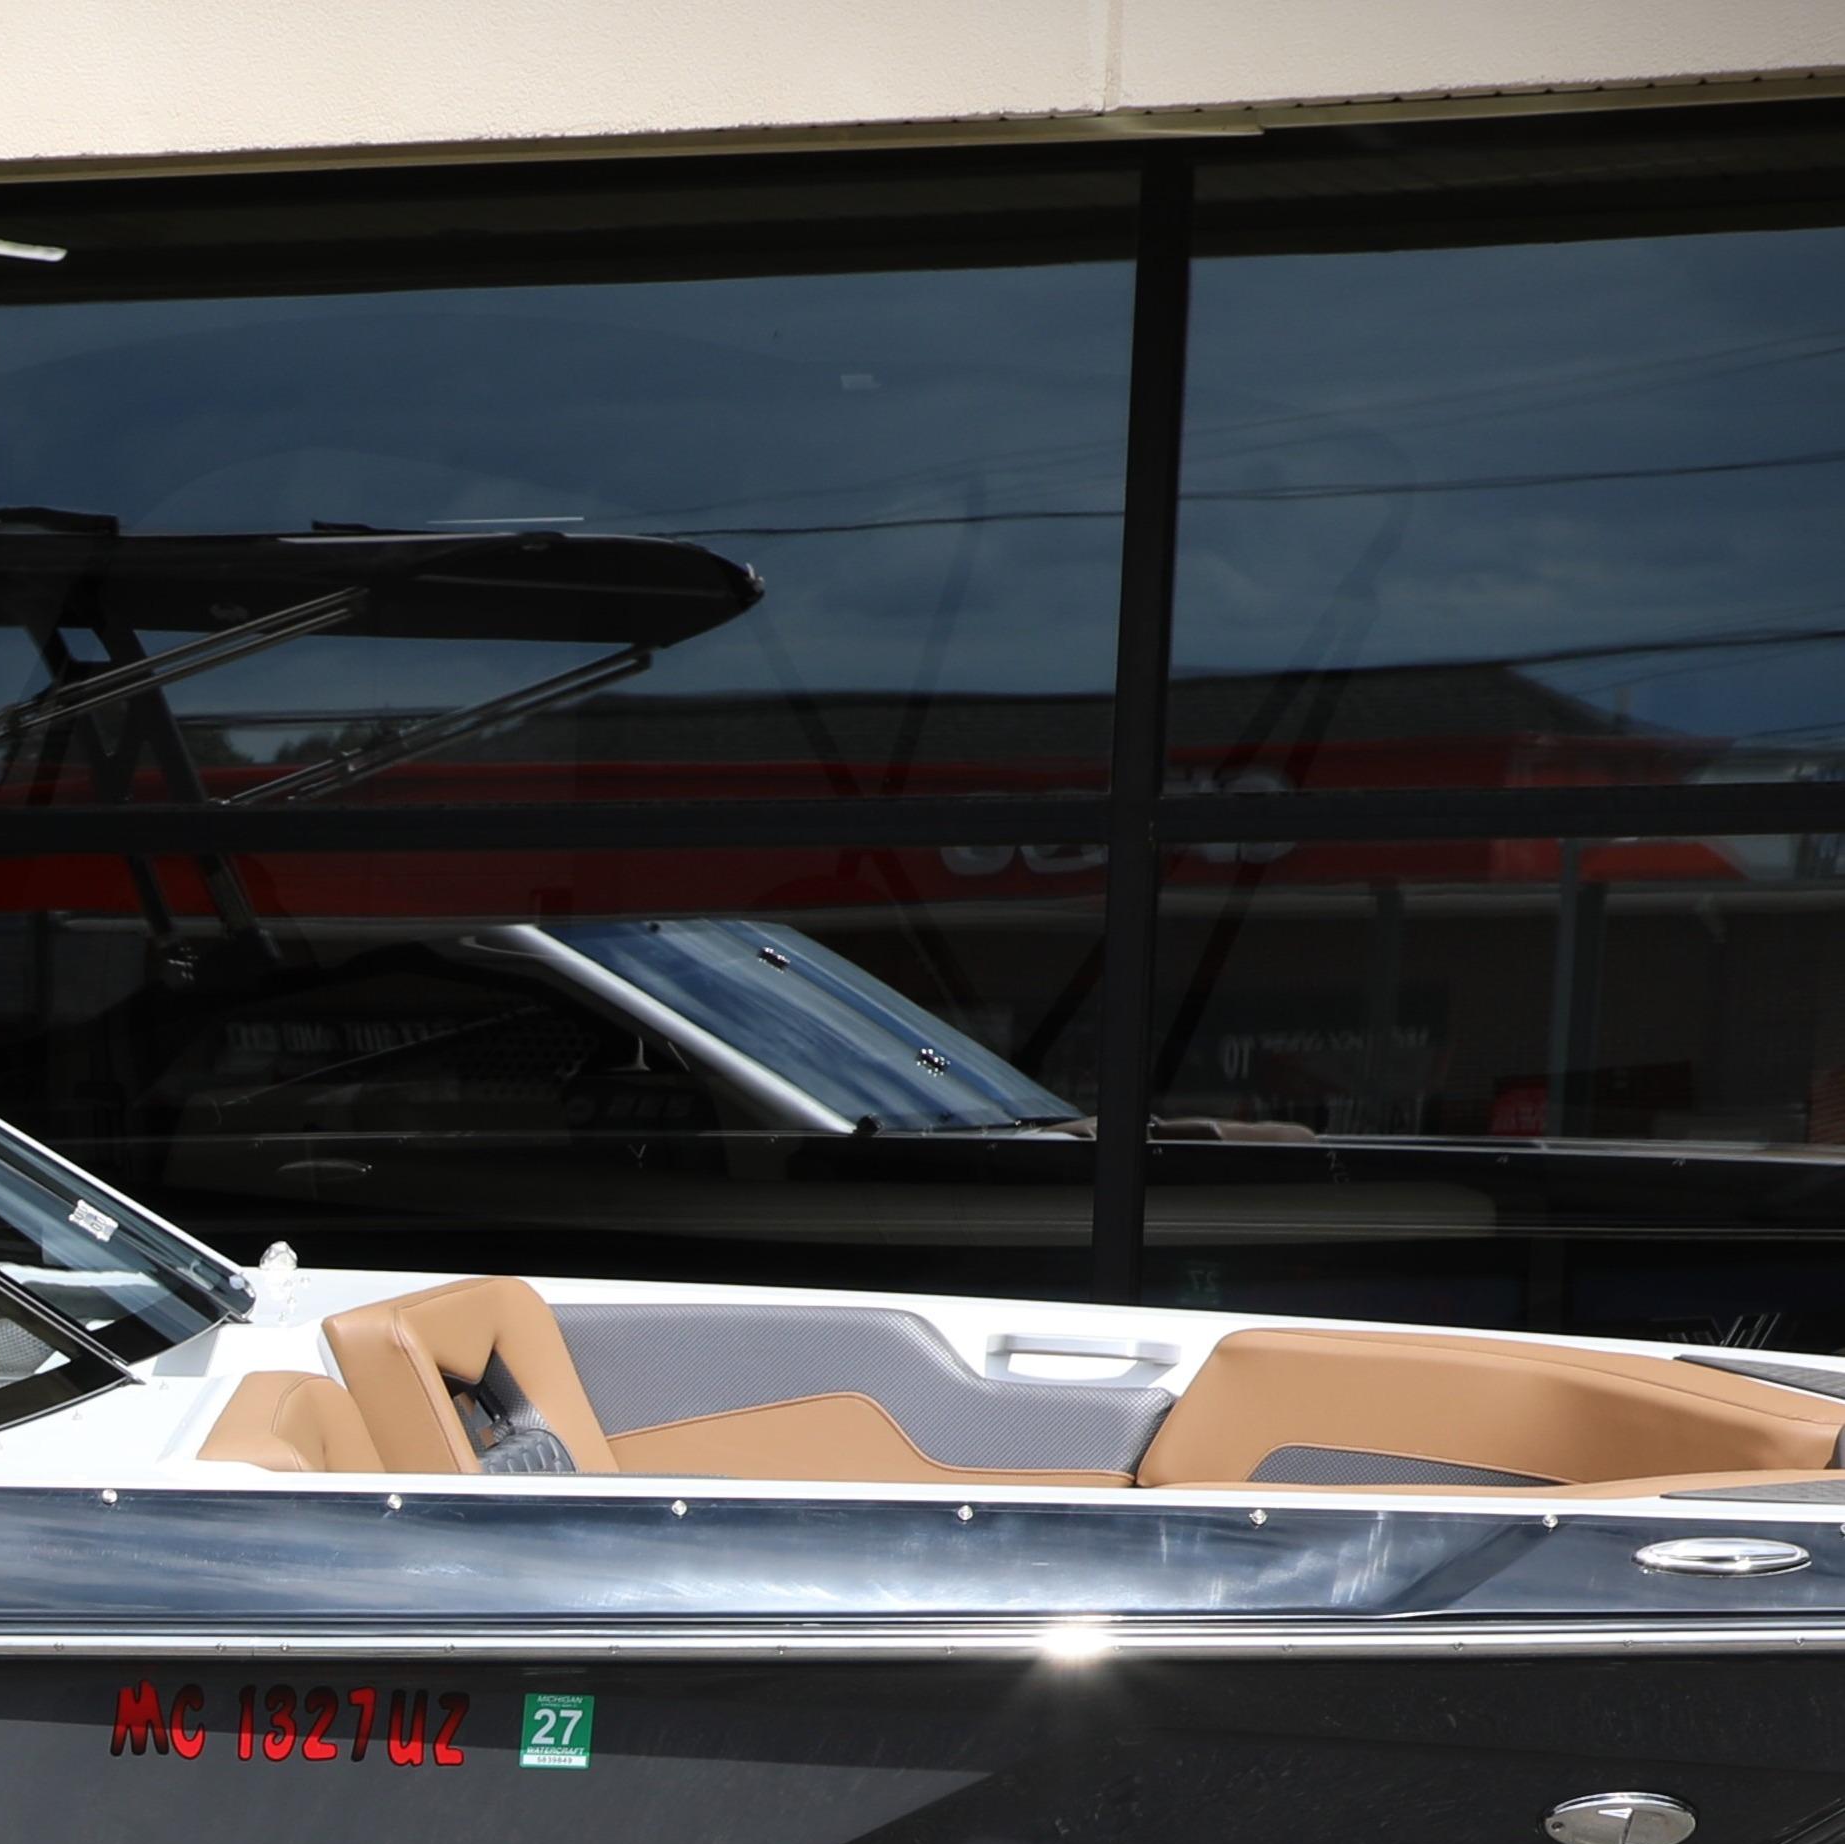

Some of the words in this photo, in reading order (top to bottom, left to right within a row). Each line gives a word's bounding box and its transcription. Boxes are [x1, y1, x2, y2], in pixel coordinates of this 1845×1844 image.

[536, 1695, 583, 1703] MICHIGAN
[110, 1680, 206, 1760] MC
[531, 1708, 583, 1746] 27
[526, 1746, 585, 1756] WATERCRAFT
